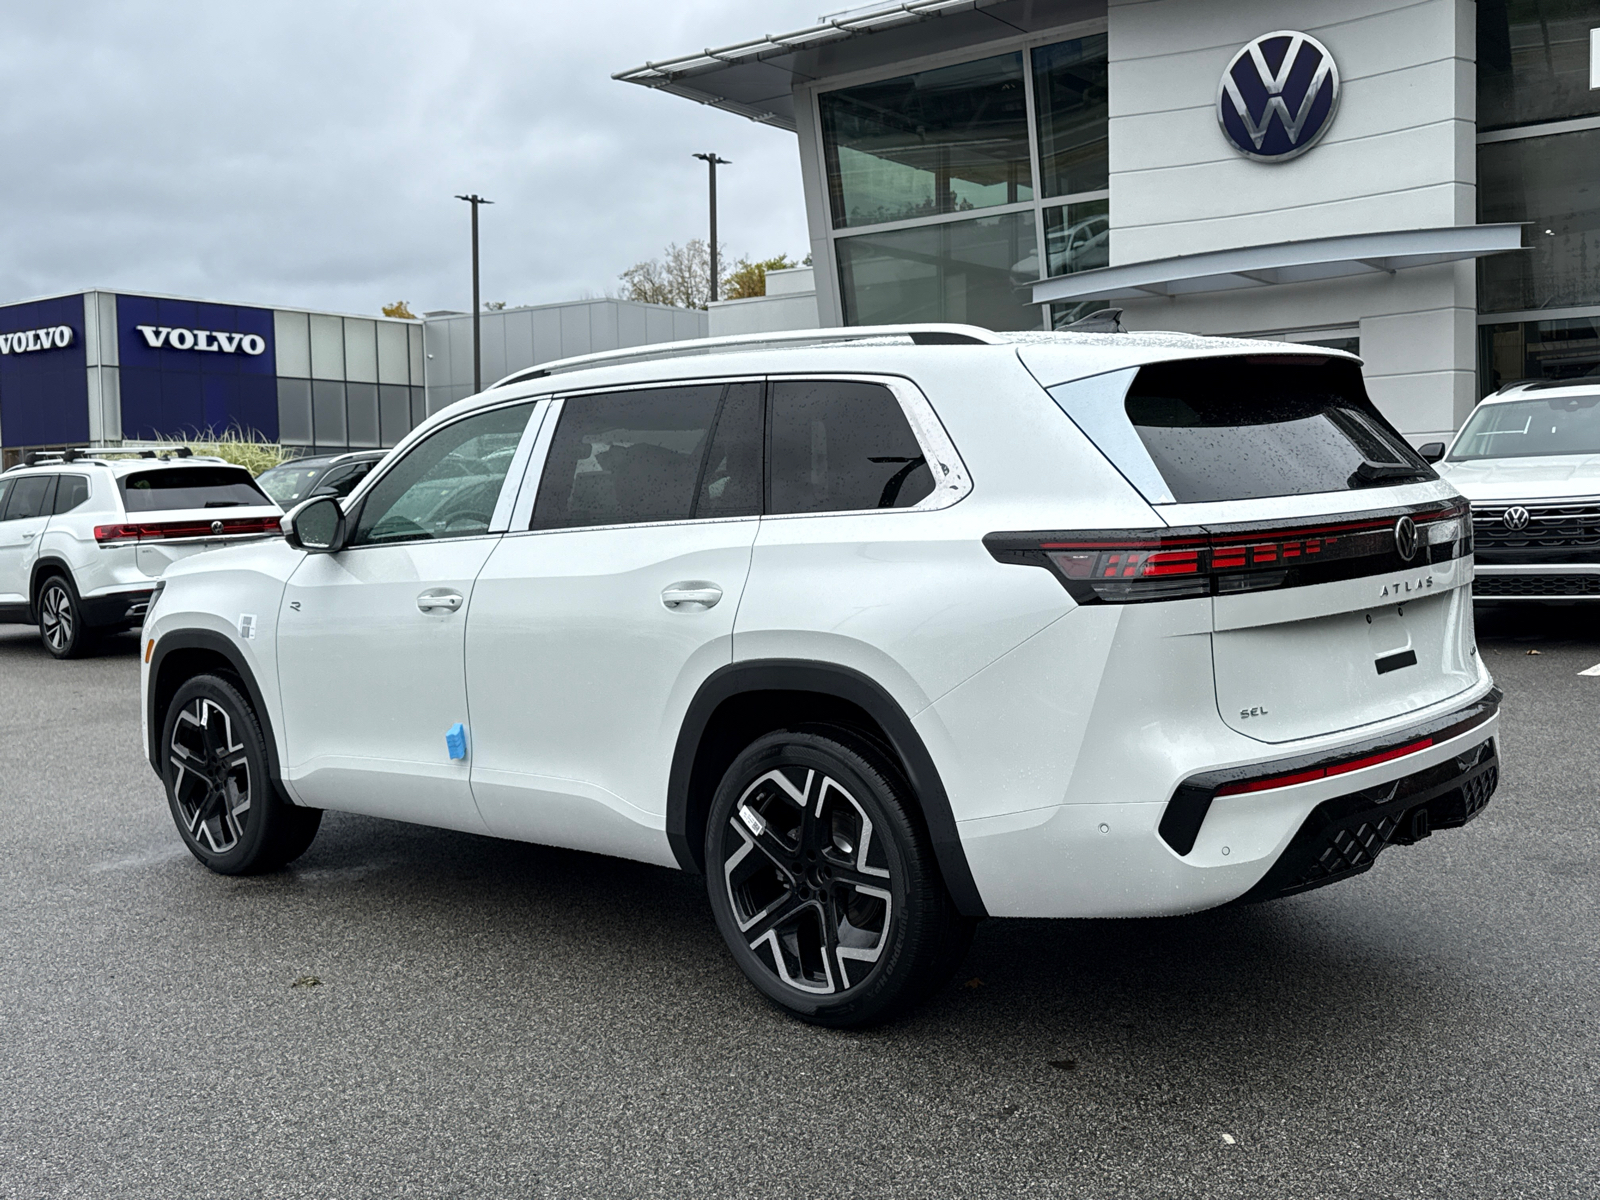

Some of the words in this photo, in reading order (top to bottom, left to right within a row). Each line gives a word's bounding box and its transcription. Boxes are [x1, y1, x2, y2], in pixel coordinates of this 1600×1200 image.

[1217, 30, 1340, 163] VW
[0, 325, 73, 354] VOLVO
[136, 325, 265, 355] VOLVO
[1503, 506, 1529, 531] VW
[1395, 516, 1418, 561] VW
[1380, 576, 1433, 598] ATLAS
[1240, 706, 1269, 719] SEL
